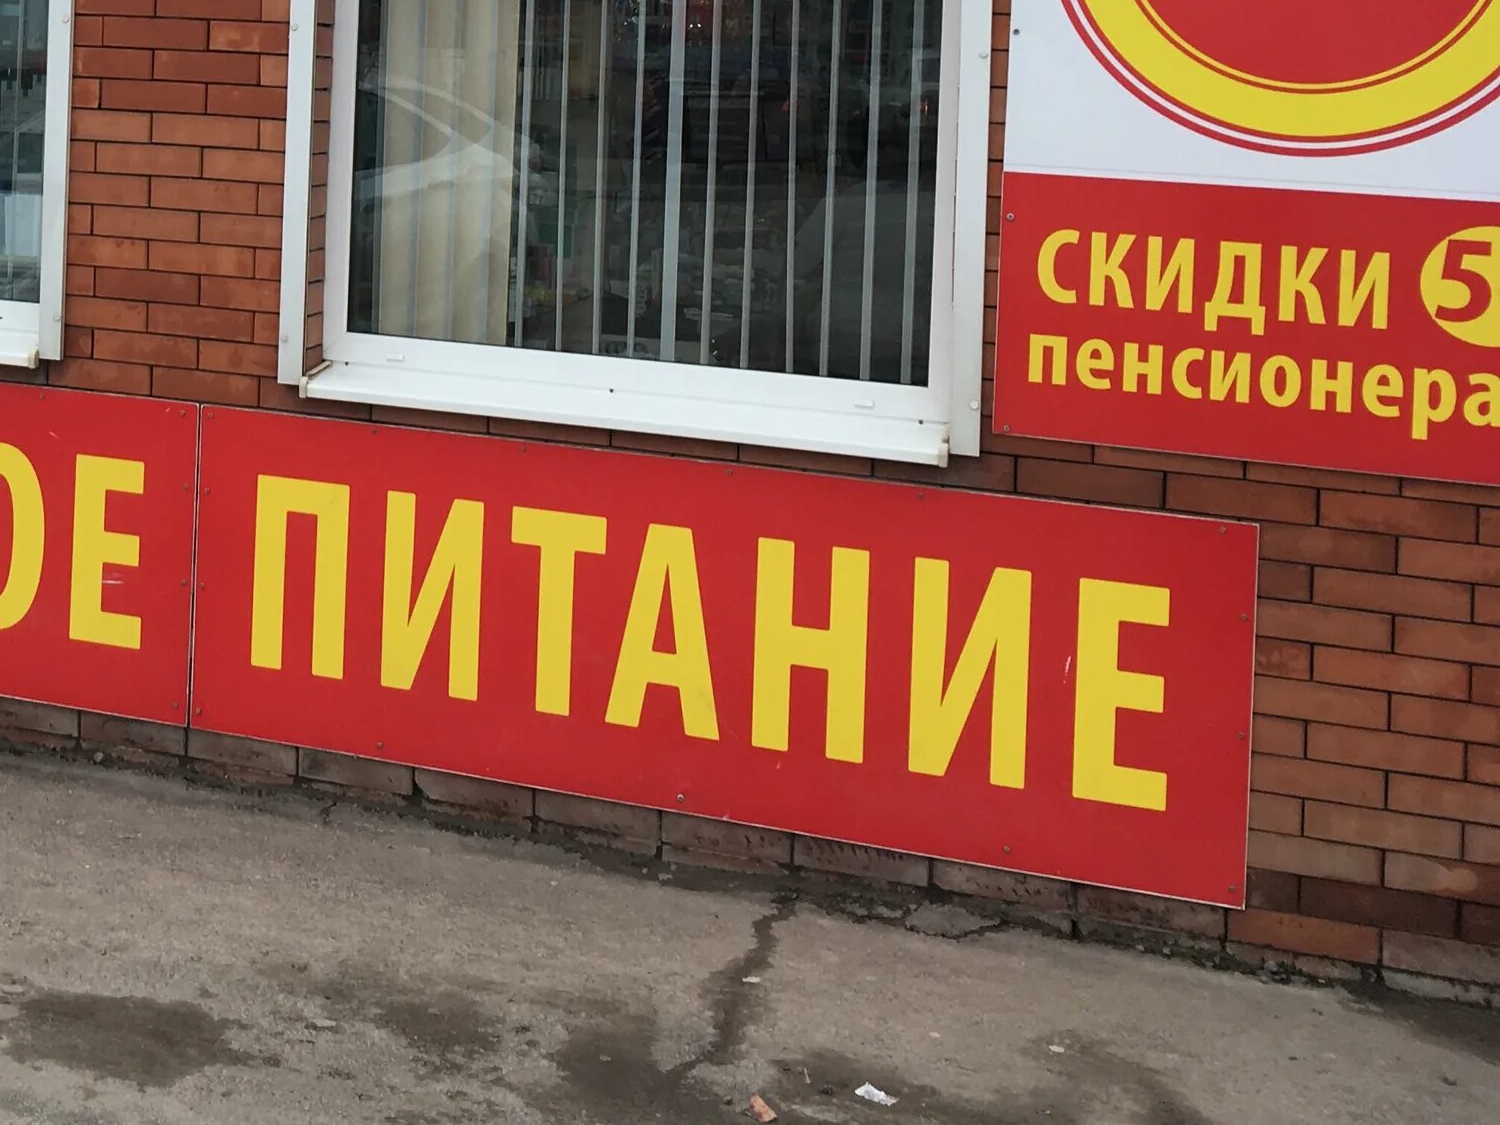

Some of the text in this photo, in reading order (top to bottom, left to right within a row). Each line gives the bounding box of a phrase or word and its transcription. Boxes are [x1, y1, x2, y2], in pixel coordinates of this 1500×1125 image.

[1037, 229, 1492, 336] СКИДКИ 5
[1028, 333, 1500, 441] пенсионера
[250, 473, 1171, 812] ПИТАНИЕ
